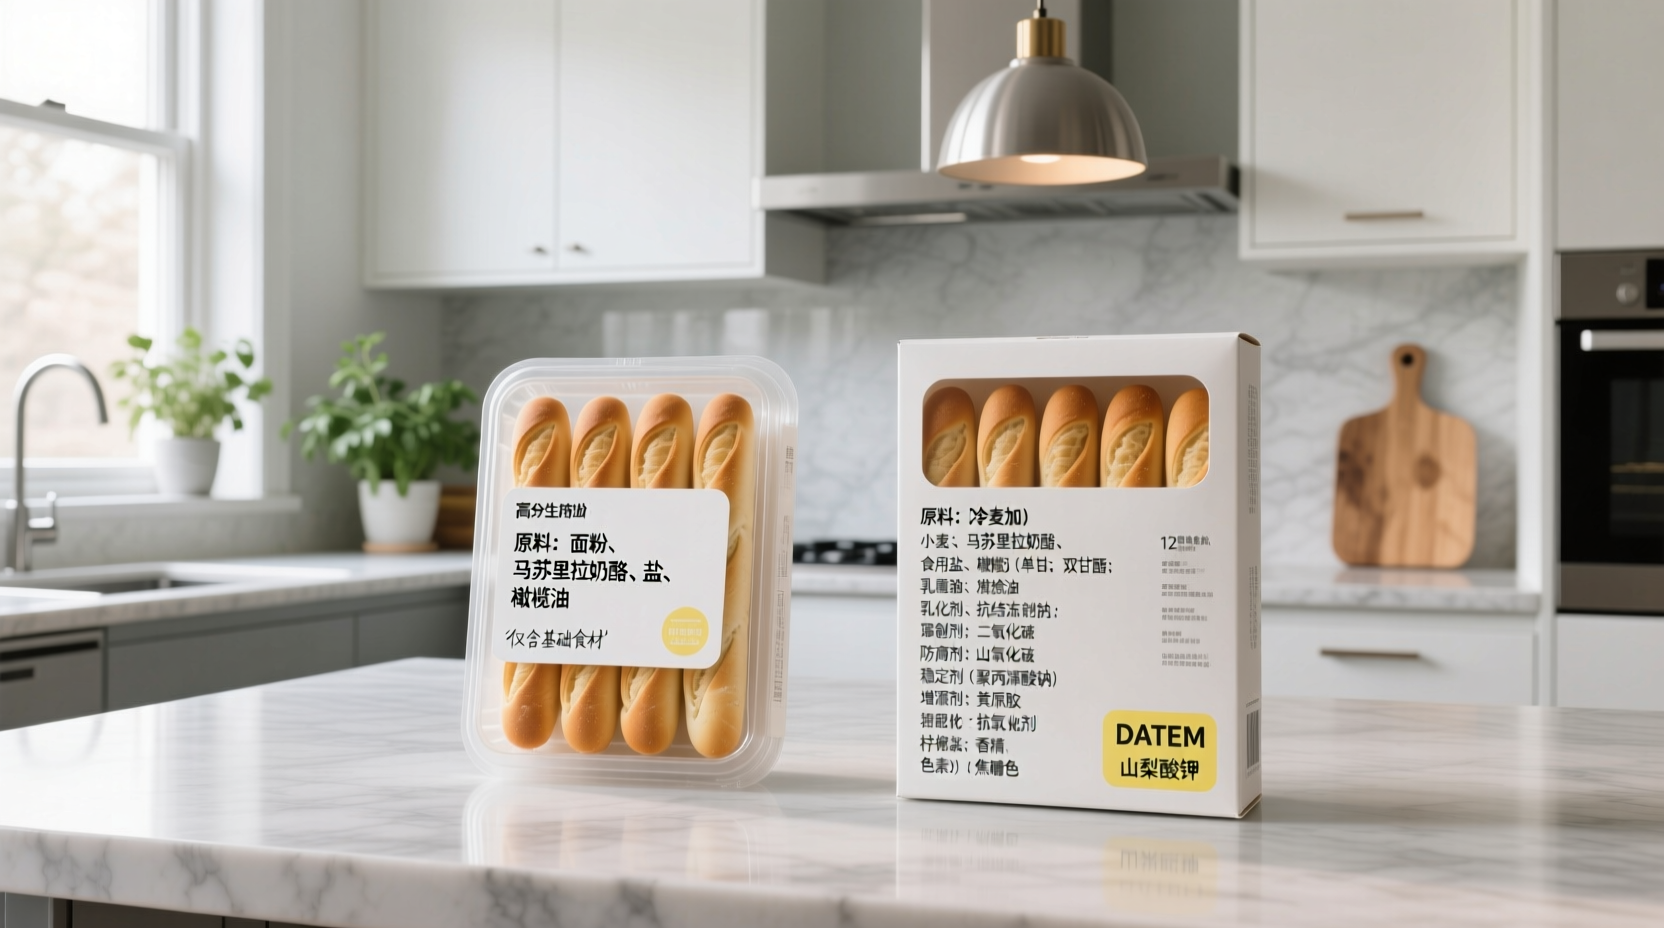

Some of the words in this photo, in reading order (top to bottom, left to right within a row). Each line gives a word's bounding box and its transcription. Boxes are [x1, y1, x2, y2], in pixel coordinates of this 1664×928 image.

[510, 586, 570, 609] 橄榄油
[1116, 723, 1205, 748] DATEM
[1120, 757, 1199, 781] 山梨酸钾
